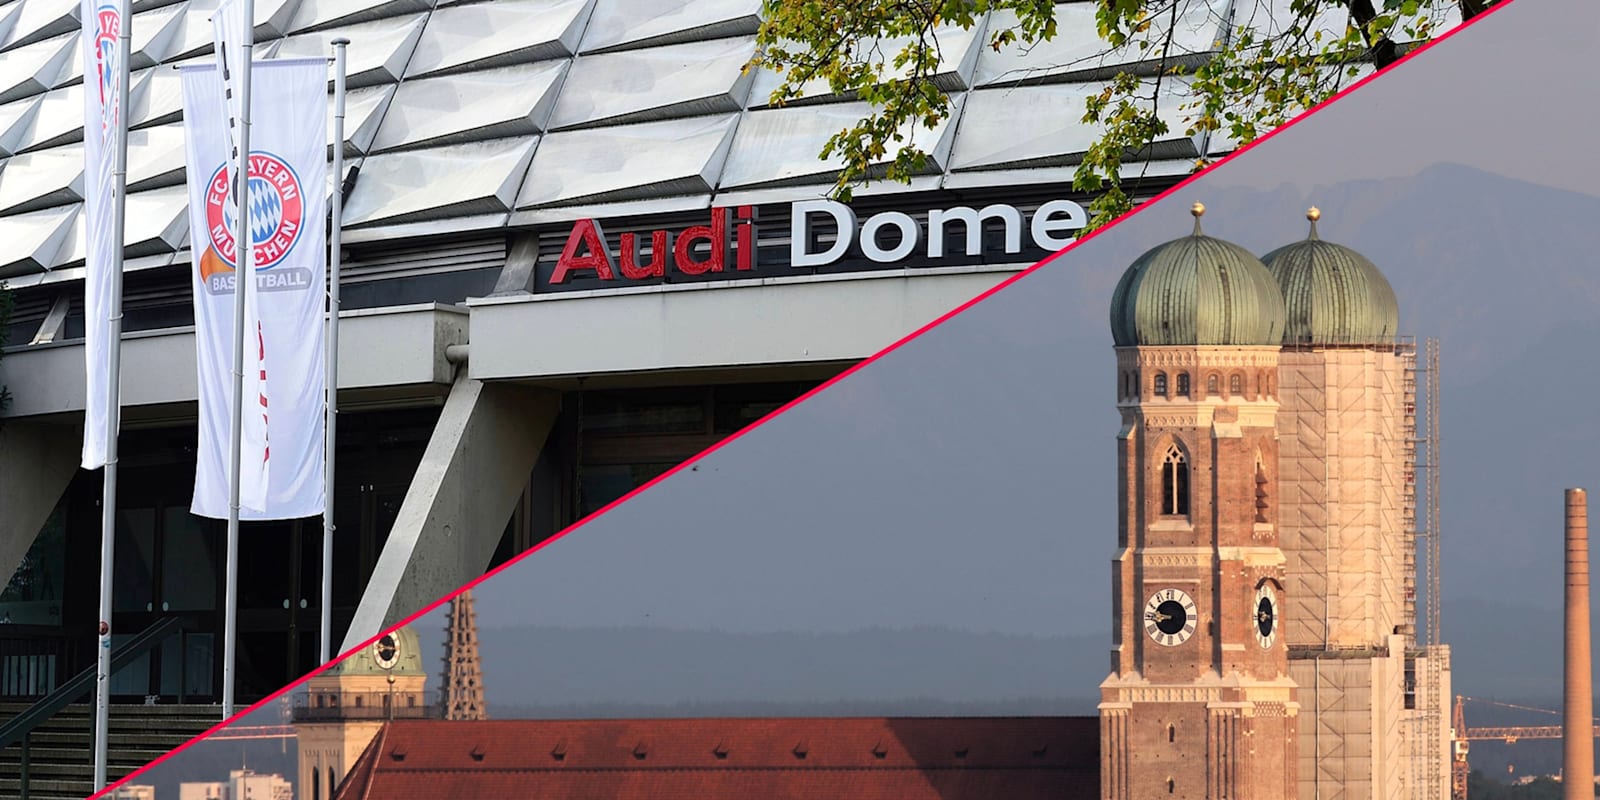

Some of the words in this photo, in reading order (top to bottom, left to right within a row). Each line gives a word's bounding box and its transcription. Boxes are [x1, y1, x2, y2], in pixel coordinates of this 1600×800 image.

[209, 178, 228, 206] FC
[212, 219, 297, 264] MÜCHEN
[550, 204, 753, 283] Audi
[791, 200, 1088, 267] Dome
[212, 272, 307, 291] BASTBALL
